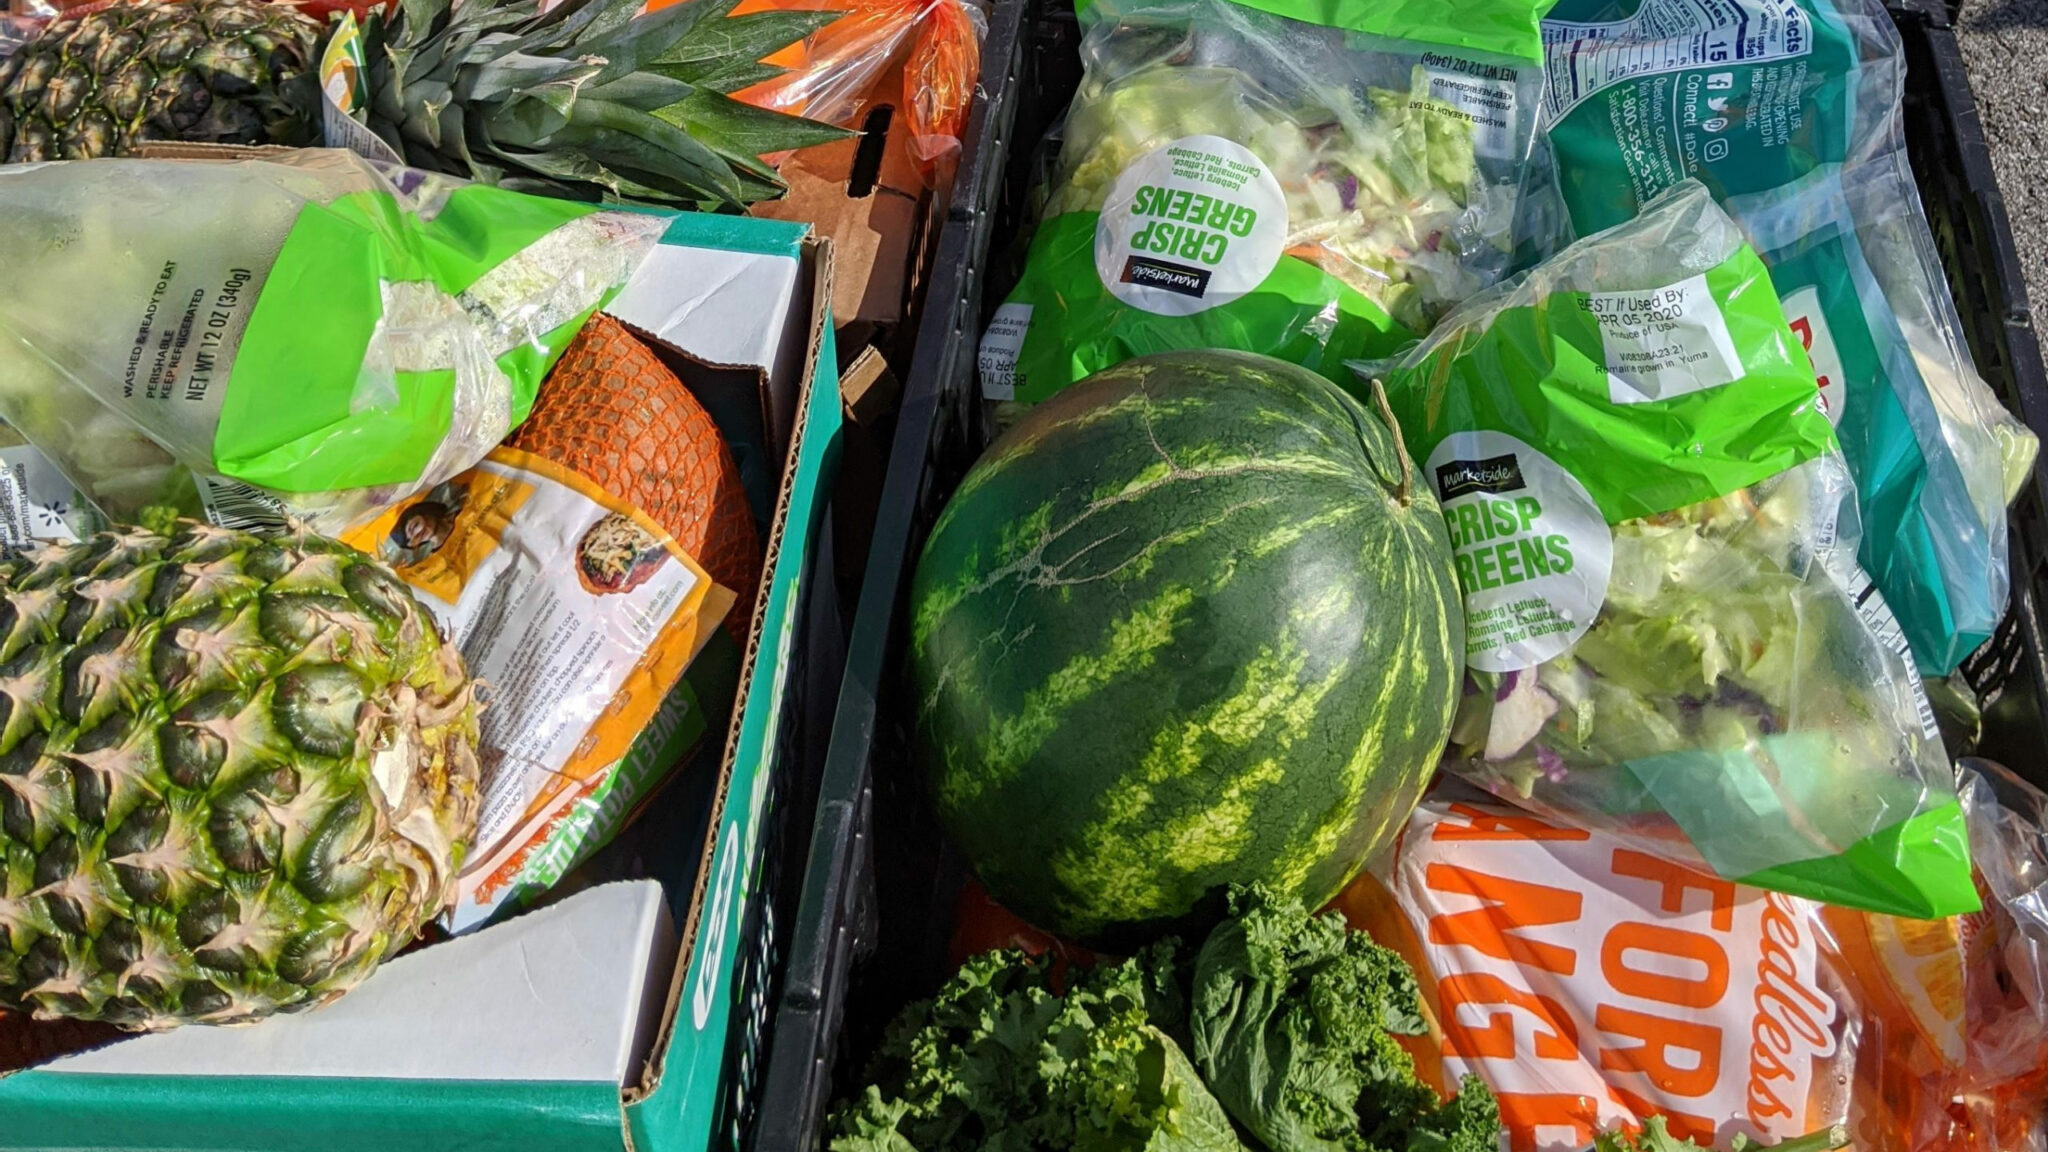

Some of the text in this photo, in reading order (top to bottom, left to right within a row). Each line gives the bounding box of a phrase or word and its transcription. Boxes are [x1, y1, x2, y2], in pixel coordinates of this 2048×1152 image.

[1785, 6, 1801, 53] Facts
[1709, 40, 1728, 62] 15
[1421, 52, 1518, 82] NET WT 12 OZ (340g)
[1434, 78, 1512, 100] KEEP REFRIGERATED
[1654, 77, 1667, 123] Questions?
[1409, 101, 1423, 109] EAT
[1424, 102, 1434, 111] TO
[1436, 106, 1462, 119] READY
[1463, 94, 1511, 111] PERISHABLE
[1472, 116, 1506, 128] WASHED
[1608, 91, 1626, 151] Satisfaction
[1640, 80, 1650, 96] Visit
[1648, 153, 1660, 172] call
[1655, 174, 1663, 185] us
[1685, 74, 1702, 173] Connect! #Dole
[1773, 105, 1789, 144] OPENING
[1789, 113, 1801, 130] USE
[1621, 84, 1659, 200] 1-800-356-311
[1761, 136, 1773, 146] IN
[1167, 147, 1261, 178] Carrots, Red Cabbage
[1173, 158, 1248, 184] Romaine Lettuce,
[1171, 167, 1241, 192] Iceberg Lettuce,
[1131, 185, 1257, 237] GREENS
[1131, 221, 1228, 265] CRISP
[1132, 265, 1199, 288] marketside
[1577, 287, 1689, 312] BEST If Used By:
[1622, 314, 1642, 326] 05
[1644, 304, 1683, 323] 2020
[124, 260, 176, 398] WASHED & READY TO EAT
[185, 268, 251, 400] NET WT 12 OZ (340g)
[1642, 327, 1651, 336] of
[1657, 322, 1680, 332] USA
[160, 288, 204, 399] KEEP REFRIGERATED
[146, 330, 174, 398] PERISHABLE
[996, 360, 1019, 371] APR
[1638, 362, 1663, 374] grown
[1665, 361, 1675, 370] in
[1680, 351, 1708, 365] Yuma
[997, 373, 1026, 386] BEST
[1443, 464, 1513, 489] marketside
[1444, 496, 1542, 549] CRISP
[1456, 534, 1574, 594] REENS
[1468, 606, 1506, 623] Iceberg
[1468, 618, 1514, 638] Romaine
[1504, 630, 1527, 645] Red
[1529, 619, 1576, 638] Cabbage
[552, 630, 572, 656] spread
[629, 688, 690, 780] SWEET
[1427, 803, 1597, 1152] ANGE
[1746, 890, 1829, 1135] eedless
